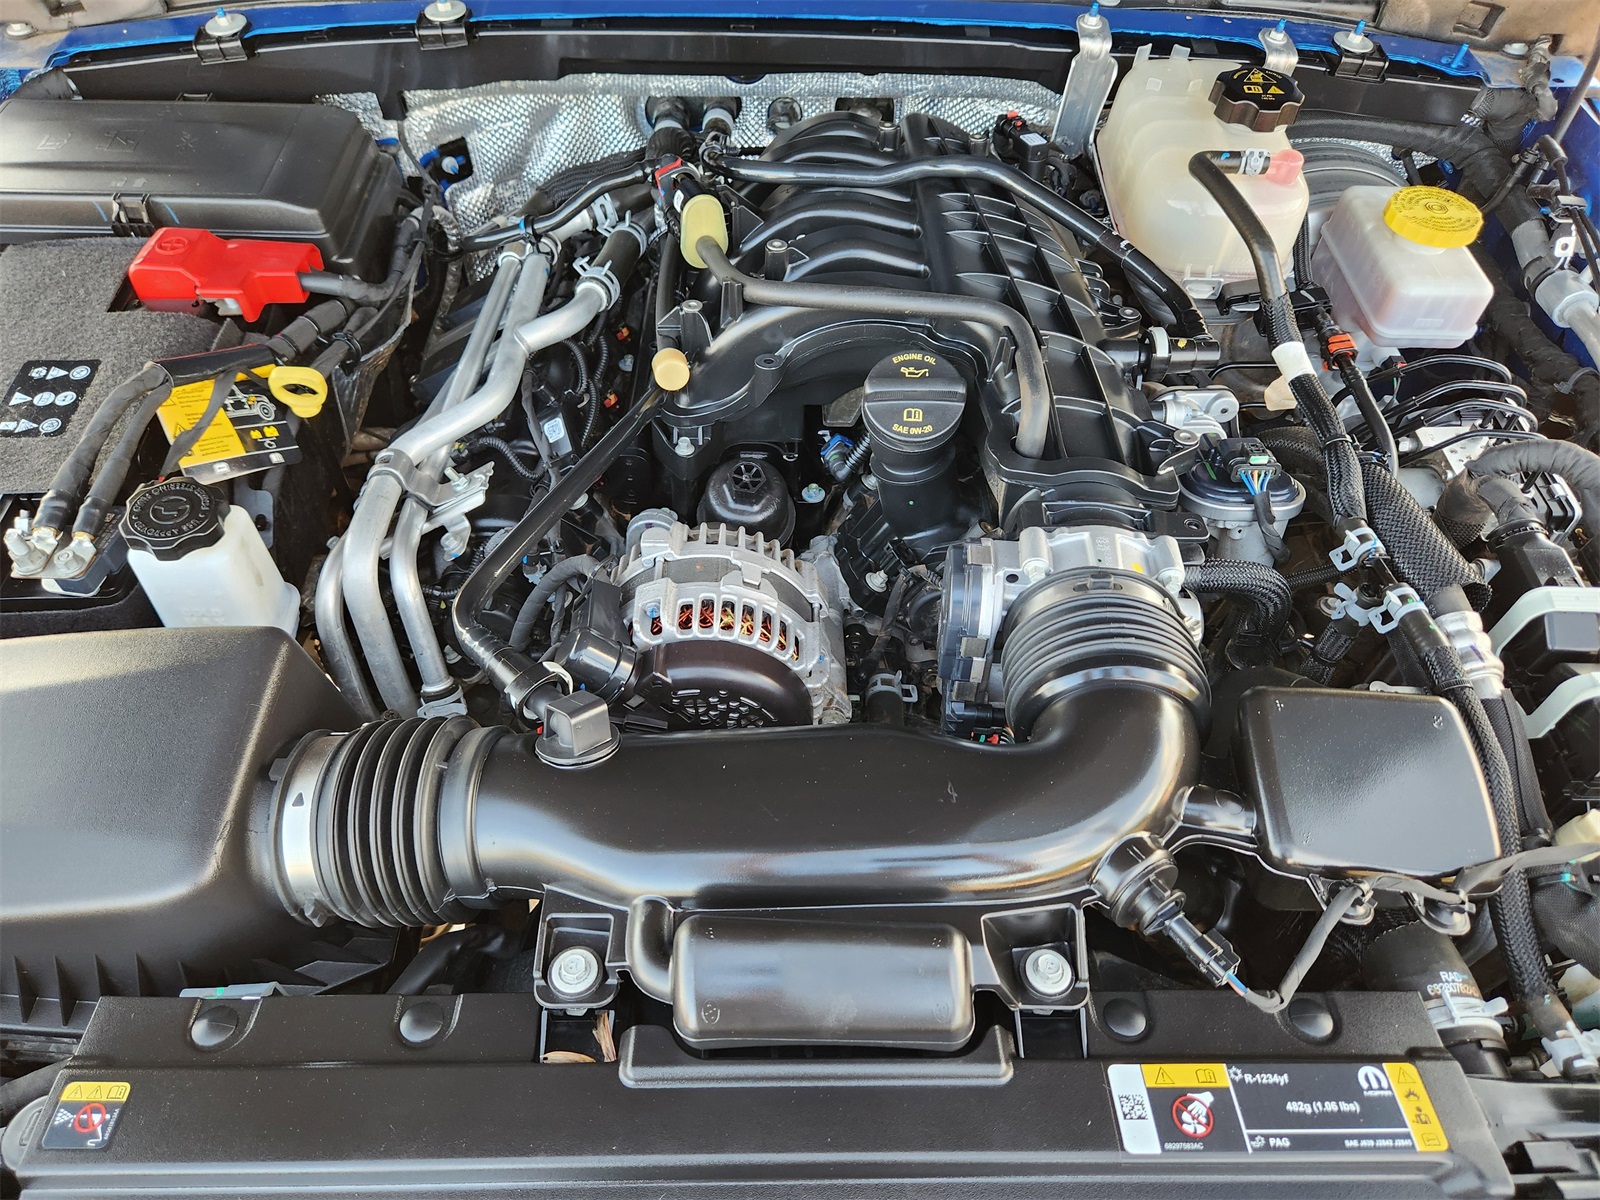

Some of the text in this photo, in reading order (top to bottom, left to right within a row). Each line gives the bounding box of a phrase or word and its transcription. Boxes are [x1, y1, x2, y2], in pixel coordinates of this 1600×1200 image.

[892, 353, 936, 365] ENGINE OIL
[892, 423, 933, 435] SAE 0W-20
[152, 483, 196, 495] STEERING
[134, 521, 179, 537] APPROVED
[1439, 971, 1462, 983] RAD
[1244, 1073, 1289, 1086] R-1234yf
[1286, 1101, 1360, 1114] 482g (1.06 lbs)
[1269, 1137, 1291, 1148] PAG
[1344, 1139, 1359, 1148] SAE
